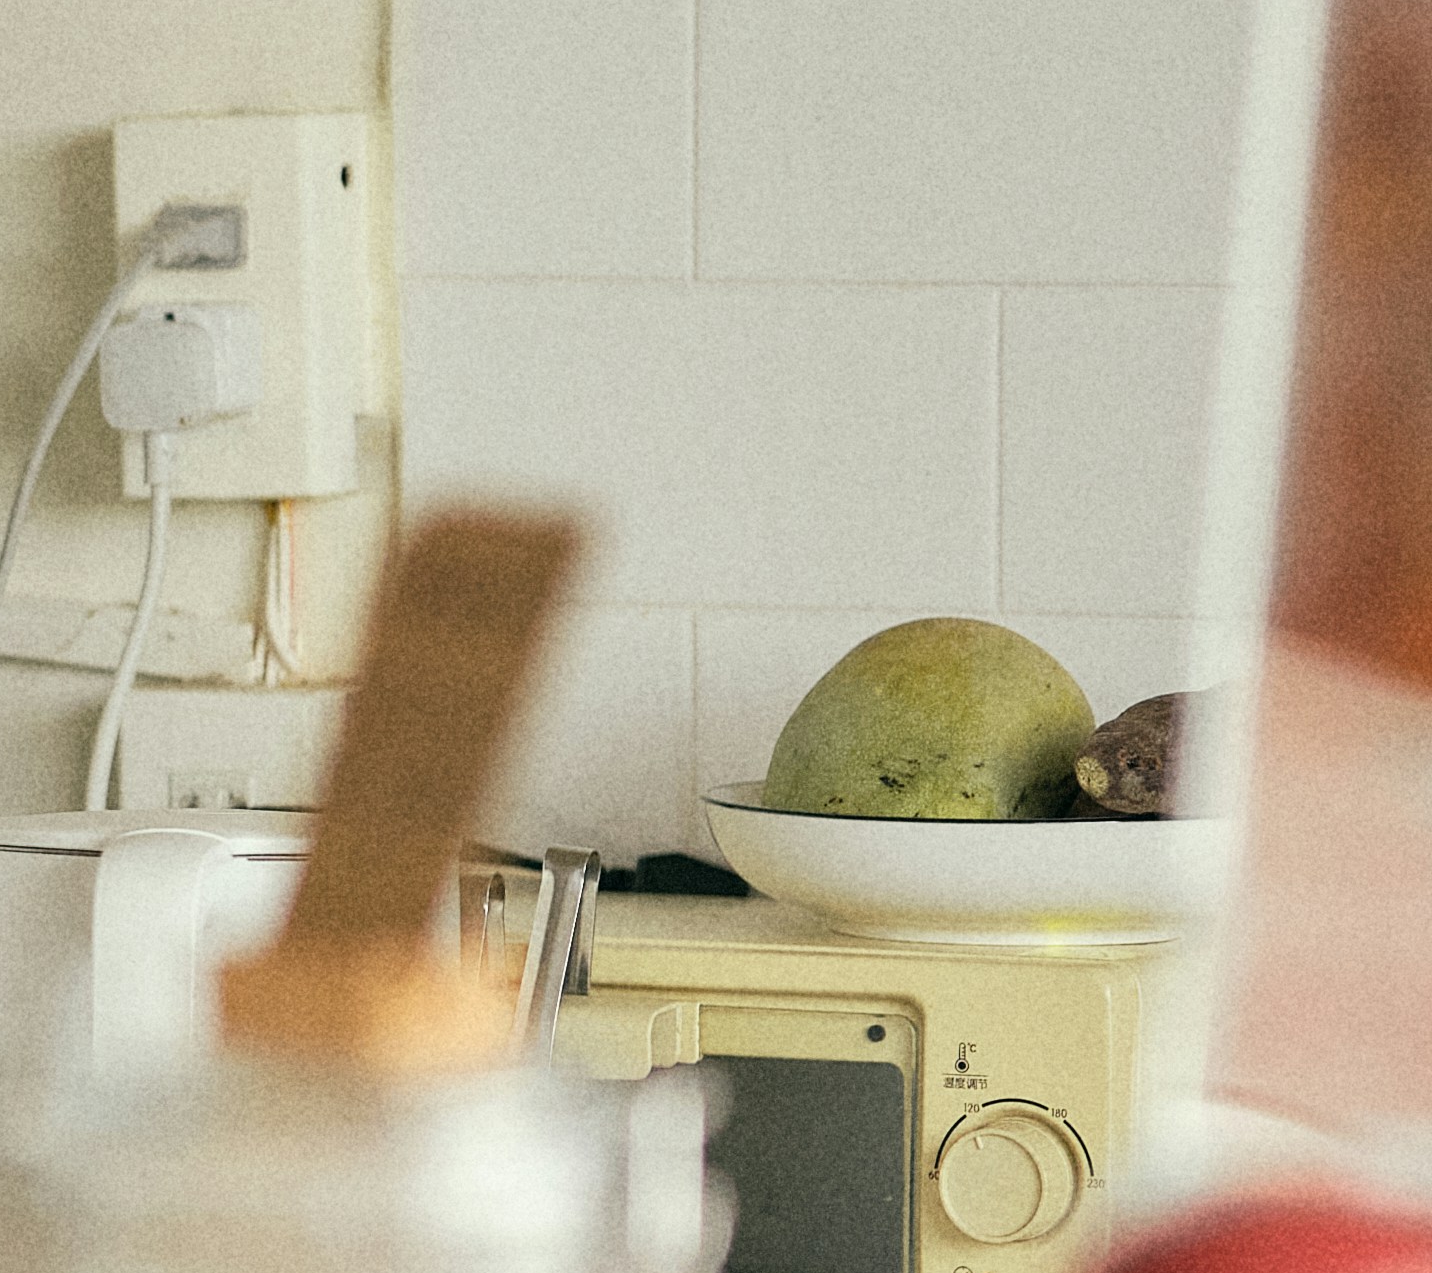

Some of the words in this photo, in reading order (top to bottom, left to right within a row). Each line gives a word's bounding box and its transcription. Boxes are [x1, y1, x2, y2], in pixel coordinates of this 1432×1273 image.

[964, 1102, 980, 1113] 120
[1051, 1108, 1068, 1118] 180
[1086, 1178, 1106, 1189] 230
